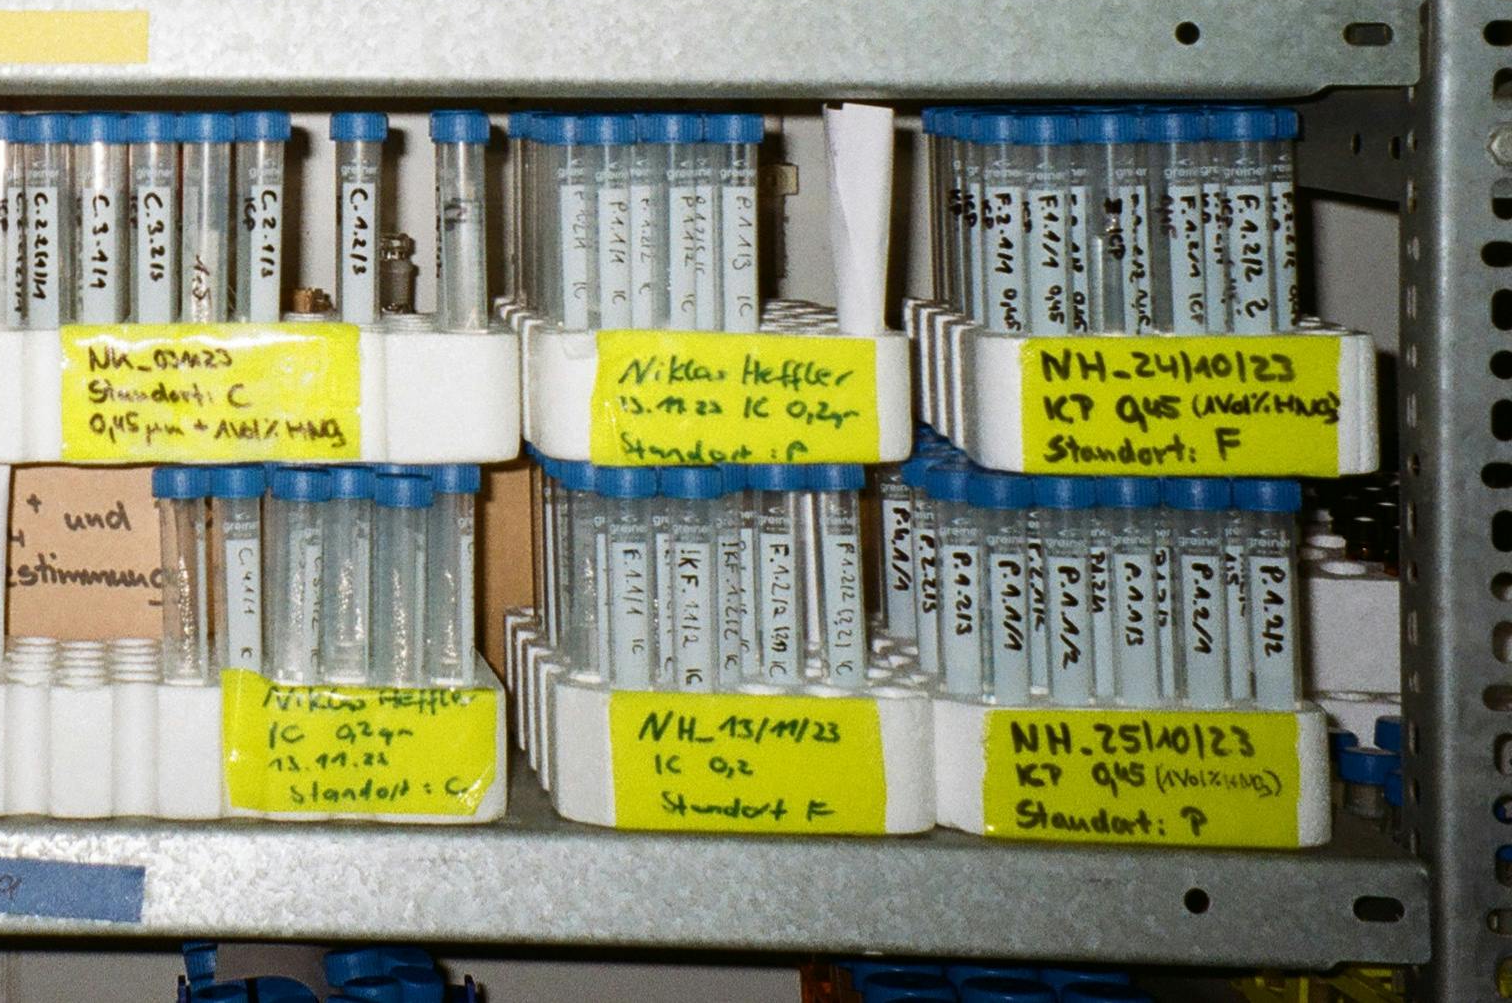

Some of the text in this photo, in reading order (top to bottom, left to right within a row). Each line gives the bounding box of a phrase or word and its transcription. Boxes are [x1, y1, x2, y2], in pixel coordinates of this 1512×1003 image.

[618, 353, 855, 392] Niklas Heffler
[226, 383, 252, 408] C
[743, 395, 769, 418] IC
[1215, 426, 1242, 461] F
[64, 500, 132, 532] und
[998, 559, 1025, 651] P.1.1/1
[1191, 562, 1215, 655] P.1.2/1
[268, 721, 306, 749] IC
[656, 754, 754, 776] IC 0,2
[444, 776, 469, 796] C
[660, 791, 835, 822] Standort F
[1180, 805, 1208, 837] P
